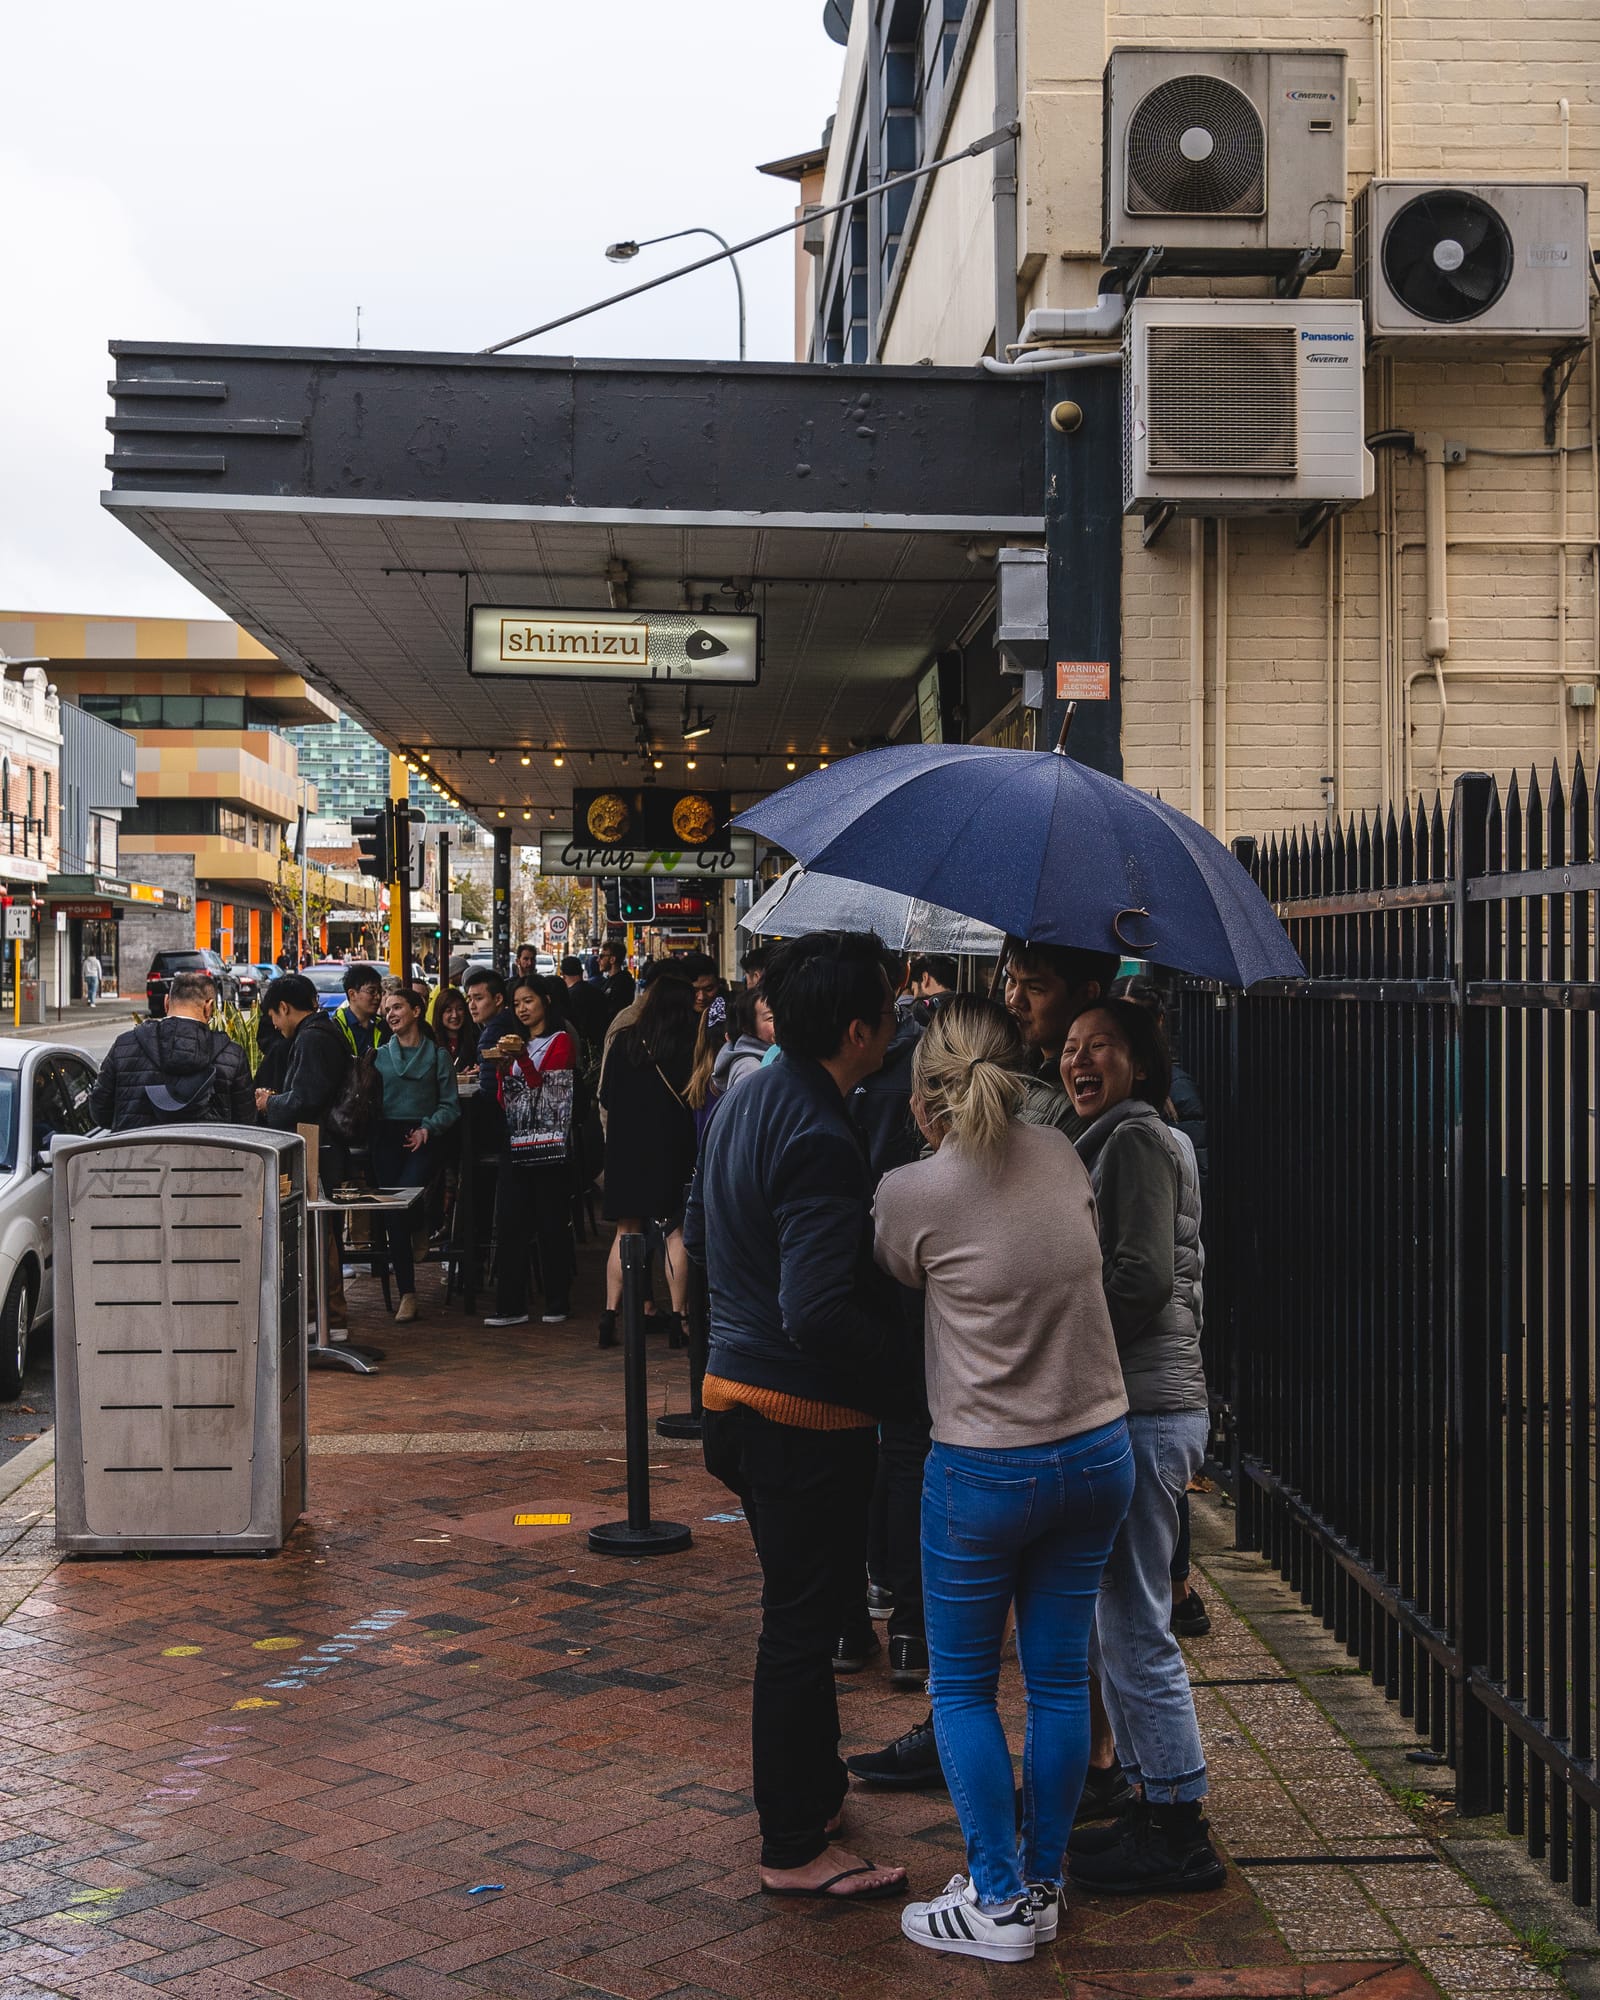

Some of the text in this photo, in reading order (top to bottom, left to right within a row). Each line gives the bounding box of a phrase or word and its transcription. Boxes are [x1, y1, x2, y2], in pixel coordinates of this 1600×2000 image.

[1301, 331, 1354, 341] Panasonic
[1310, 356, 1349, 364] INVERTER
[508, 628, 640, 655] shimizu
[1062, 664, 1105, 674] WARNING
[560, 842, 634, 871] Grab
[696, 851, 736, 873] Go
[16, 917, 20, 928] 1
[553, 920, 565, 929] 40
